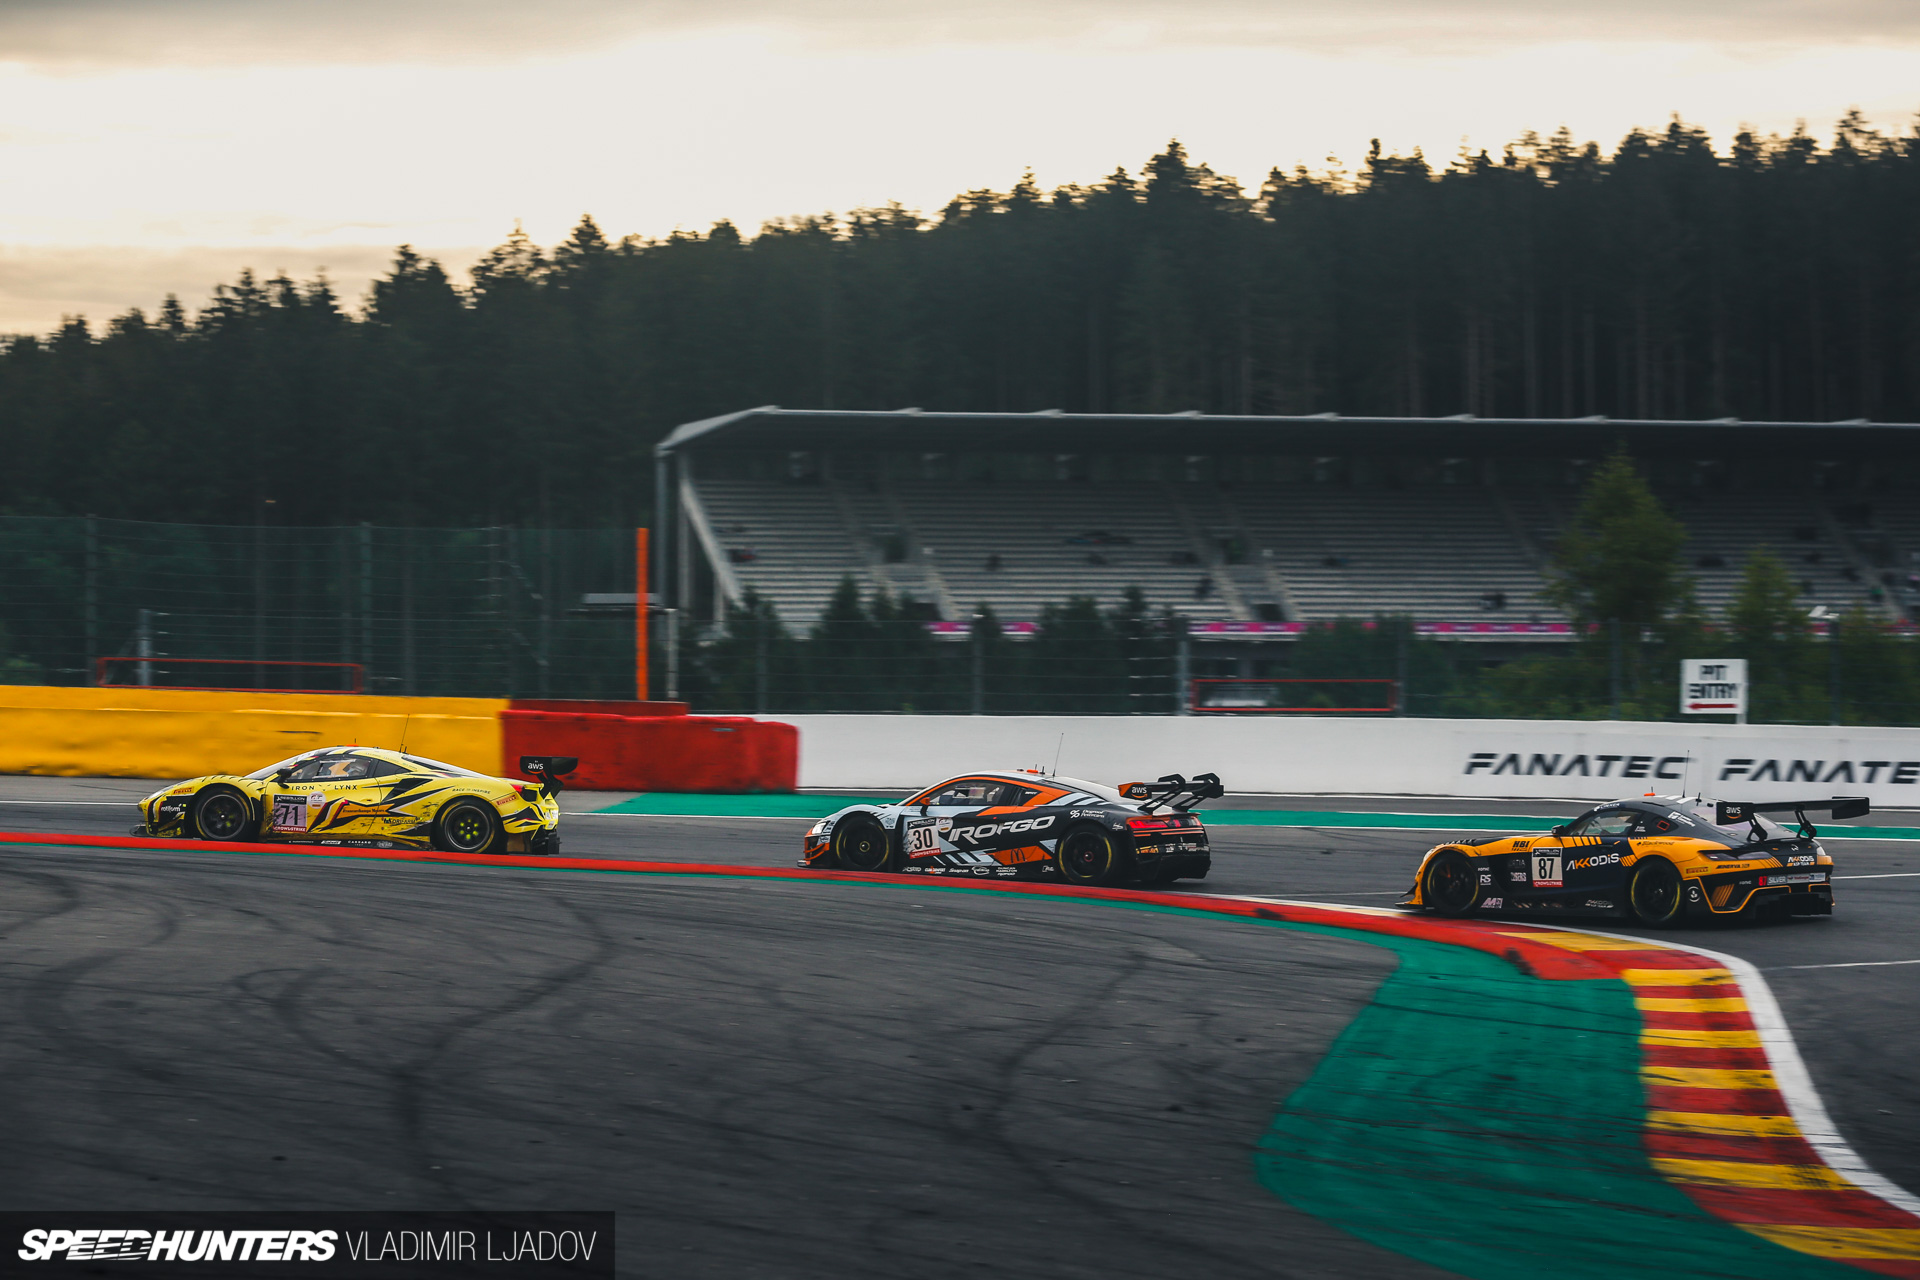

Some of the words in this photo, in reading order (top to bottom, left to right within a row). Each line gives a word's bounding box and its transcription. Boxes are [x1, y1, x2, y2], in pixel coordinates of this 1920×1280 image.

[1699, 665, 1729, 681] PIT
[1688, 683, 1738, 699] ENTRY
[527, 762, 544, 770] aws
[1463, 752, 1698, 780] FANATEC
[1131, 786, 1147, 794] aws
[496, 794, 517, 806] PIRELLI
[280, 805, 299, 825] 71
[1725, 806, 1742, 814] aws
[912, 828, 933, 850] 30
[1512, 840, 1530, 848] HBI
[1538, 857, 1555, 880] 87
[1686, 866, 1709, 874] PIRELLI
[1758, 876, 1768, 886] 87
[1768, 876, 1787, 884] SILVER
